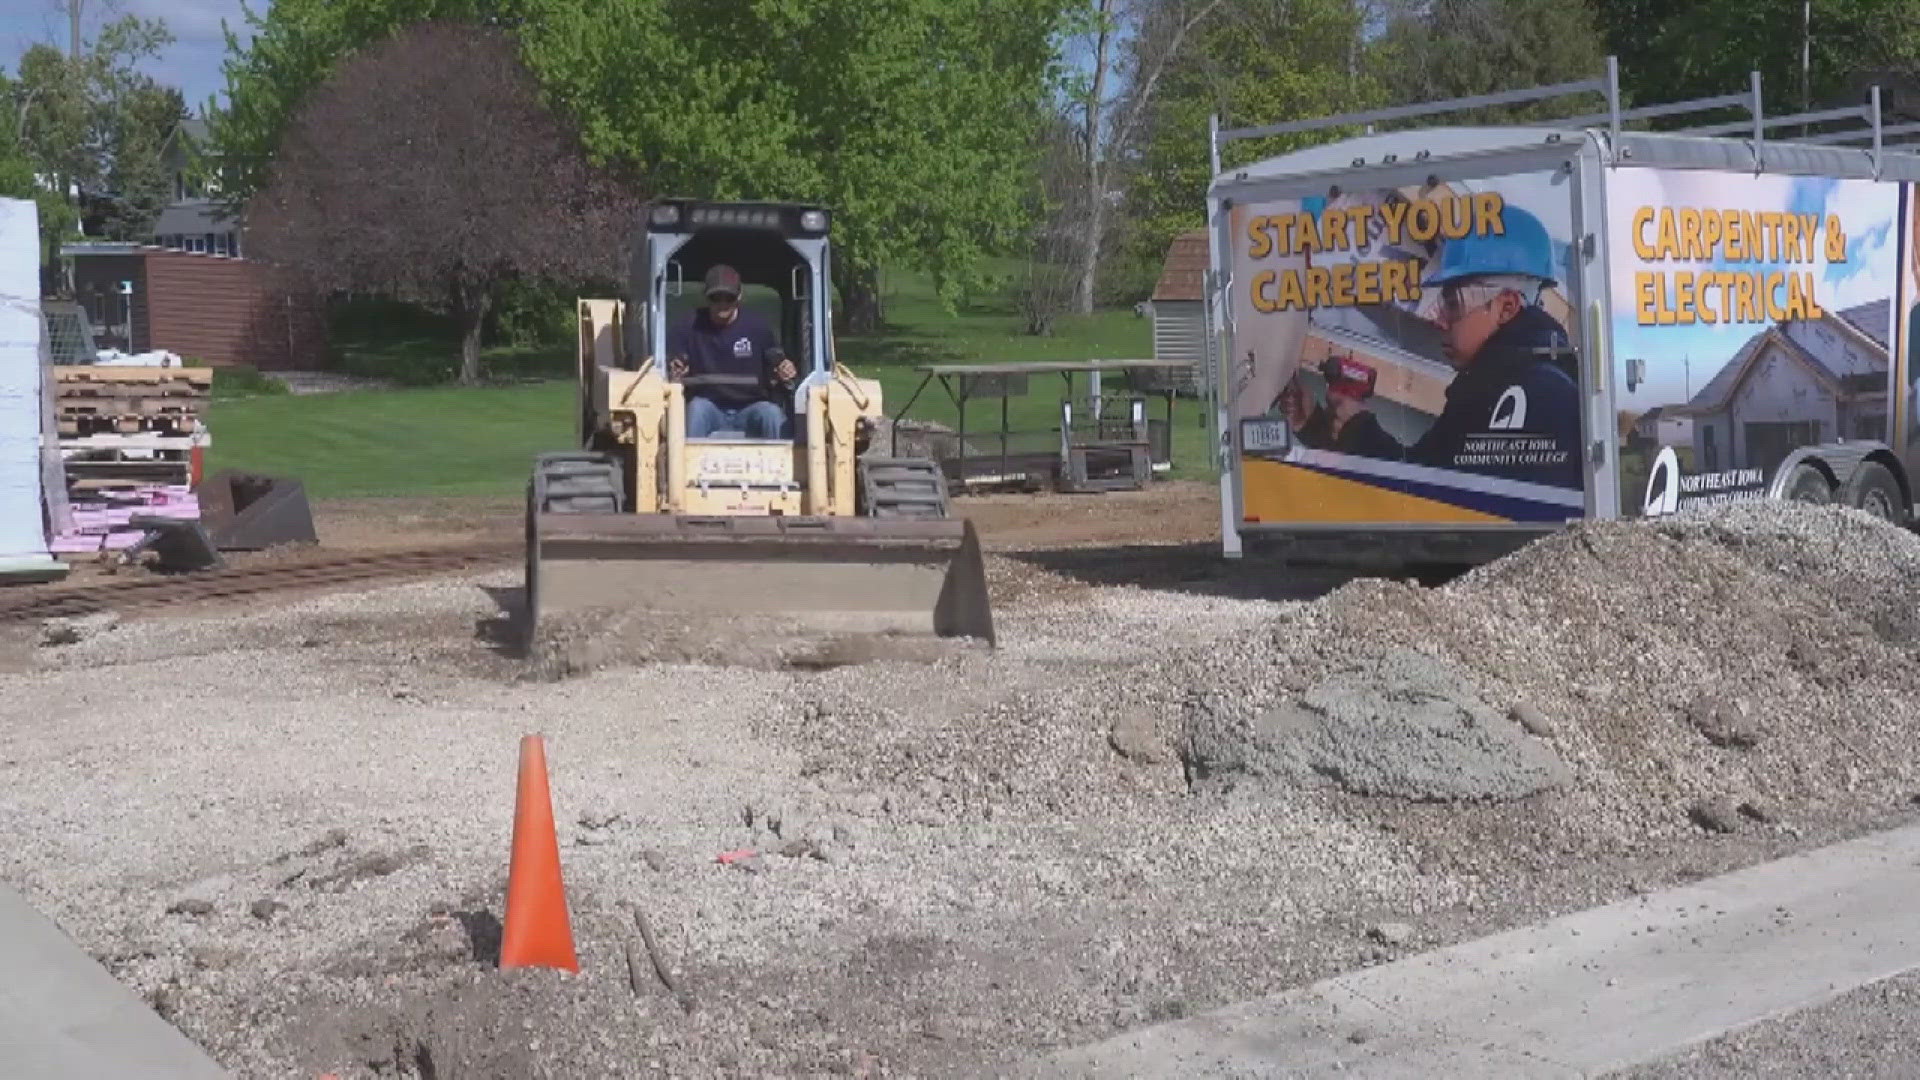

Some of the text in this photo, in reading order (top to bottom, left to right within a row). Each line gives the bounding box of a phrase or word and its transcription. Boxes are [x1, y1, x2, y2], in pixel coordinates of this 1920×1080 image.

[1248, 192, 1506, 258] START YOUR
[1632, 206, 1847, 263] CARPENTRY &
[1251, 259, 1423, 313] CAREER!
[1635, 271, 1822, 326] ELECTRICAL
[1454, 451, 1568, 464] COMMUNITY COLLEGE
[1464, 439, 1556, 452] NORTHEAST IOWA
[1680, 468, 1763, 491] NORTHEAST IOWA
